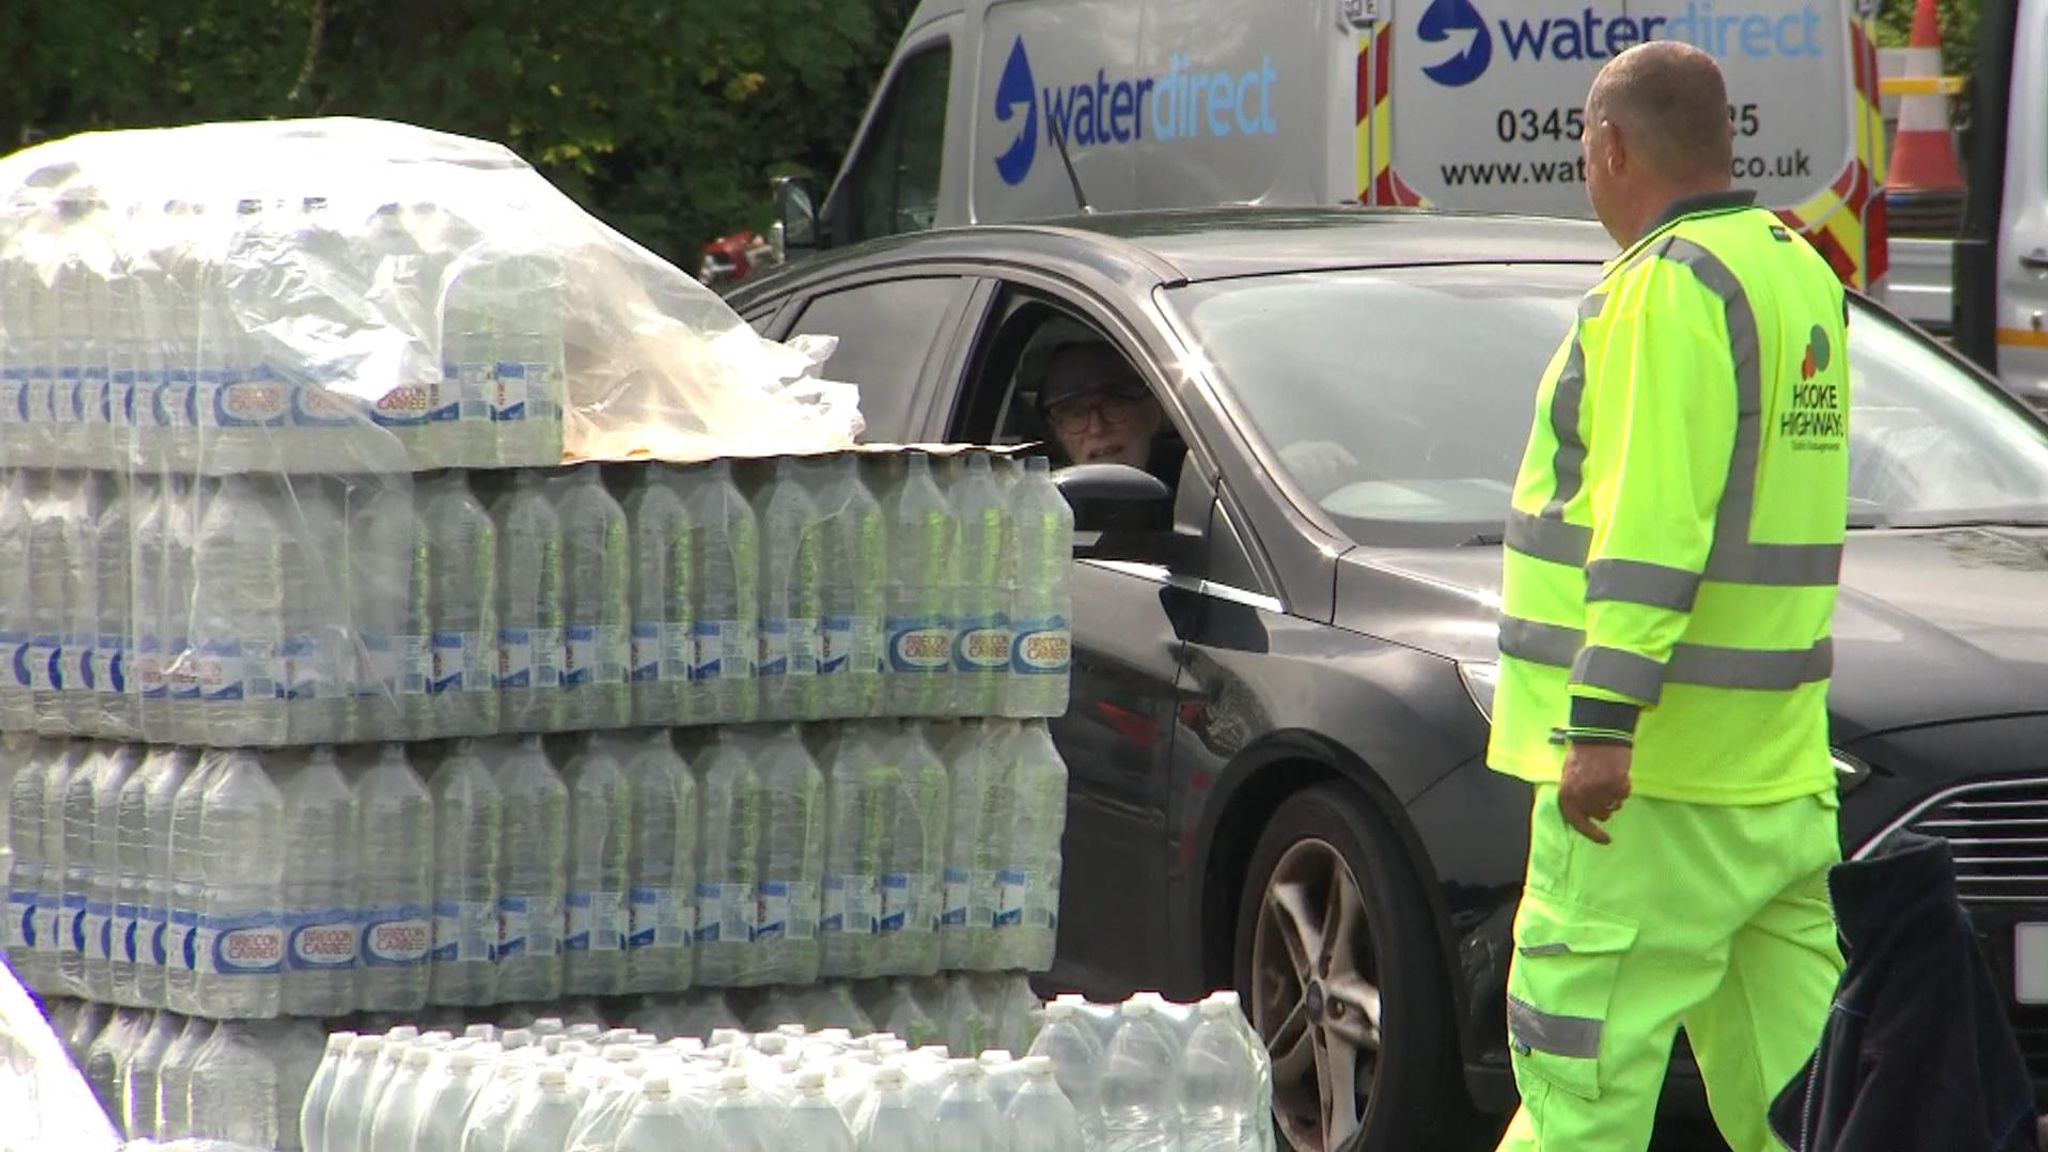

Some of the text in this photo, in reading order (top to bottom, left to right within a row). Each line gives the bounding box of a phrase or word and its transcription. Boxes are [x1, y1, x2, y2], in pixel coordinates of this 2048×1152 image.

[1498, 2, 1824, 62] waterdirect
[1043, 51, 1278, 147] waterdirect
[1497, 108, 1586, 142] 0345
